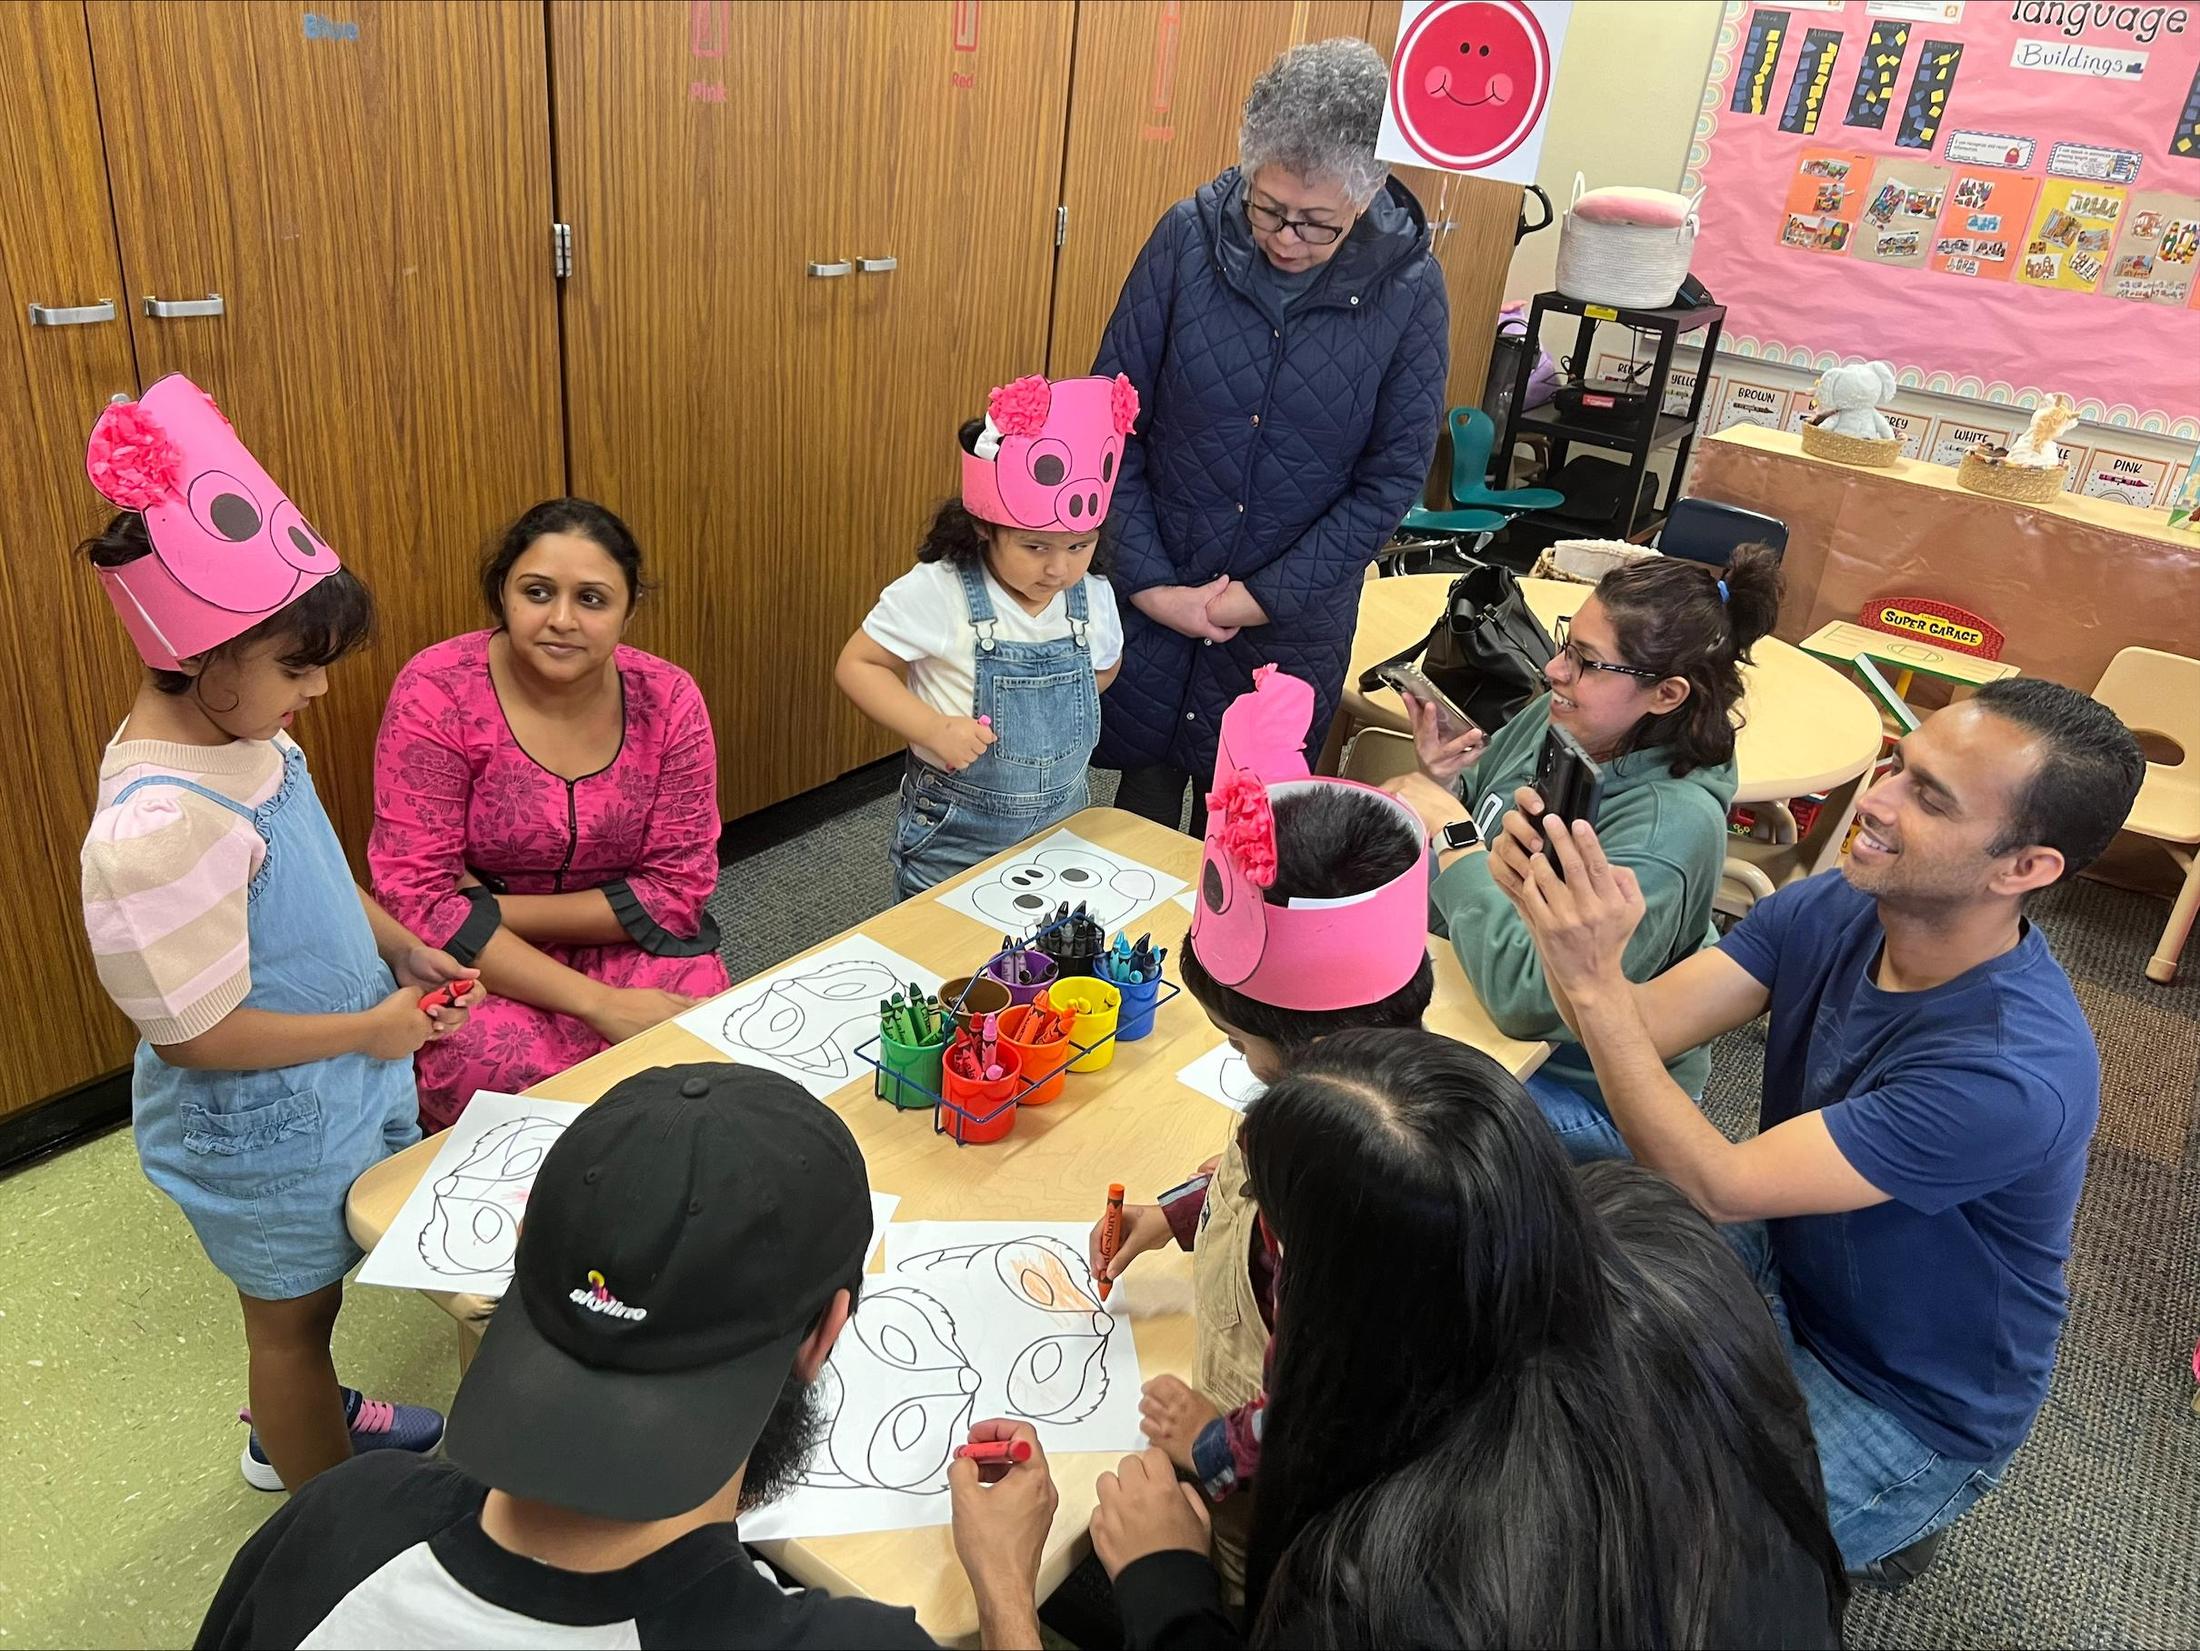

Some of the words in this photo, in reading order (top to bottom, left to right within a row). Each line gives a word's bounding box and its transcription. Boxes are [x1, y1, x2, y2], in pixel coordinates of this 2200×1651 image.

[2012, 1, 2188, 43] language
[2017, 44, 2123, 76] Buildings
[952, 72, 975, 89] Red
[689, 81, 728, 103] Pink
[1671, 374, 1697, 388] YELLO
[1738, 387, 1776, 404] BROWN
[2113, 459, 2143, 474] PINK
[1885, 610, 1927, 631] SUPER
[1929, 623, 1979, 644] GARAGE
